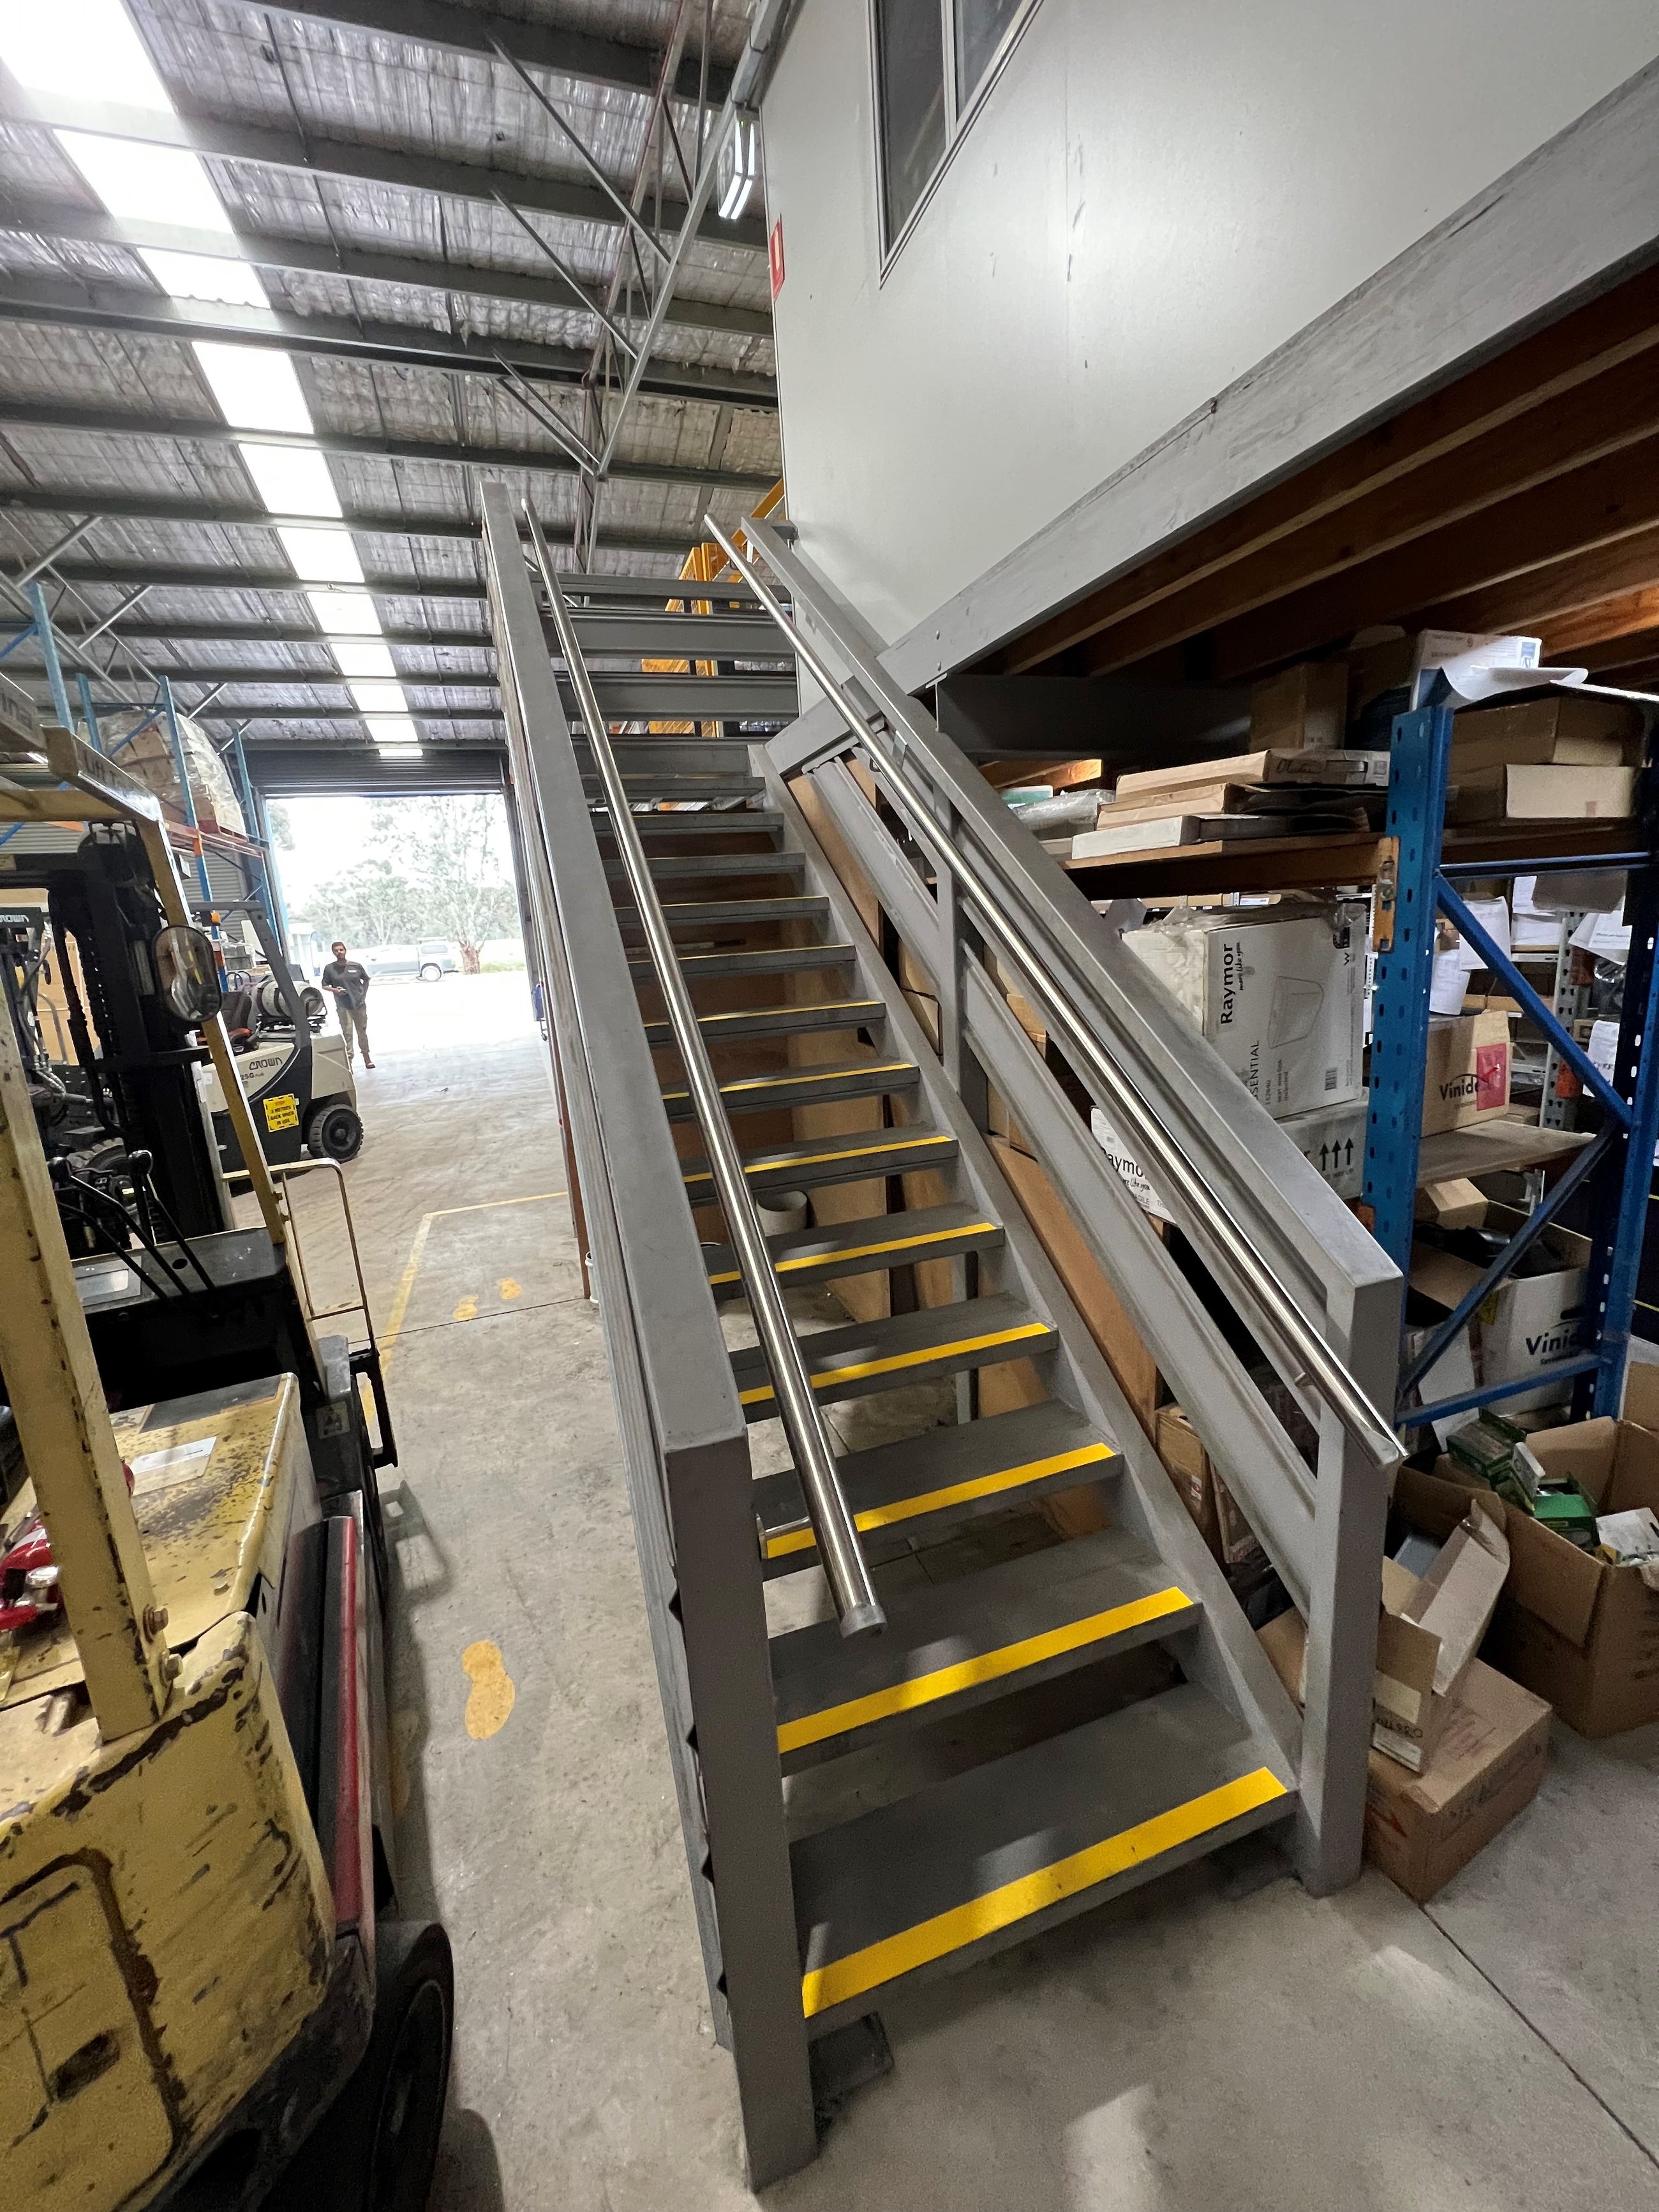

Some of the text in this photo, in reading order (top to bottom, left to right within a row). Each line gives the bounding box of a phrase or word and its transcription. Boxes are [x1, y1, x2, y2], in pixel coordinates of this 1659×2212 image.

[0, 914, 29, 923] ROWN
[1221, 944, 1235, 1024] Raymor
[249, 1057, 283, 1071] CROWN
[1250, 1040, 1259, 1101] SENTIAL
[1107, 1154, 1143, 1177] aymo
[1526, 1329, 1577, 1356] Vini
